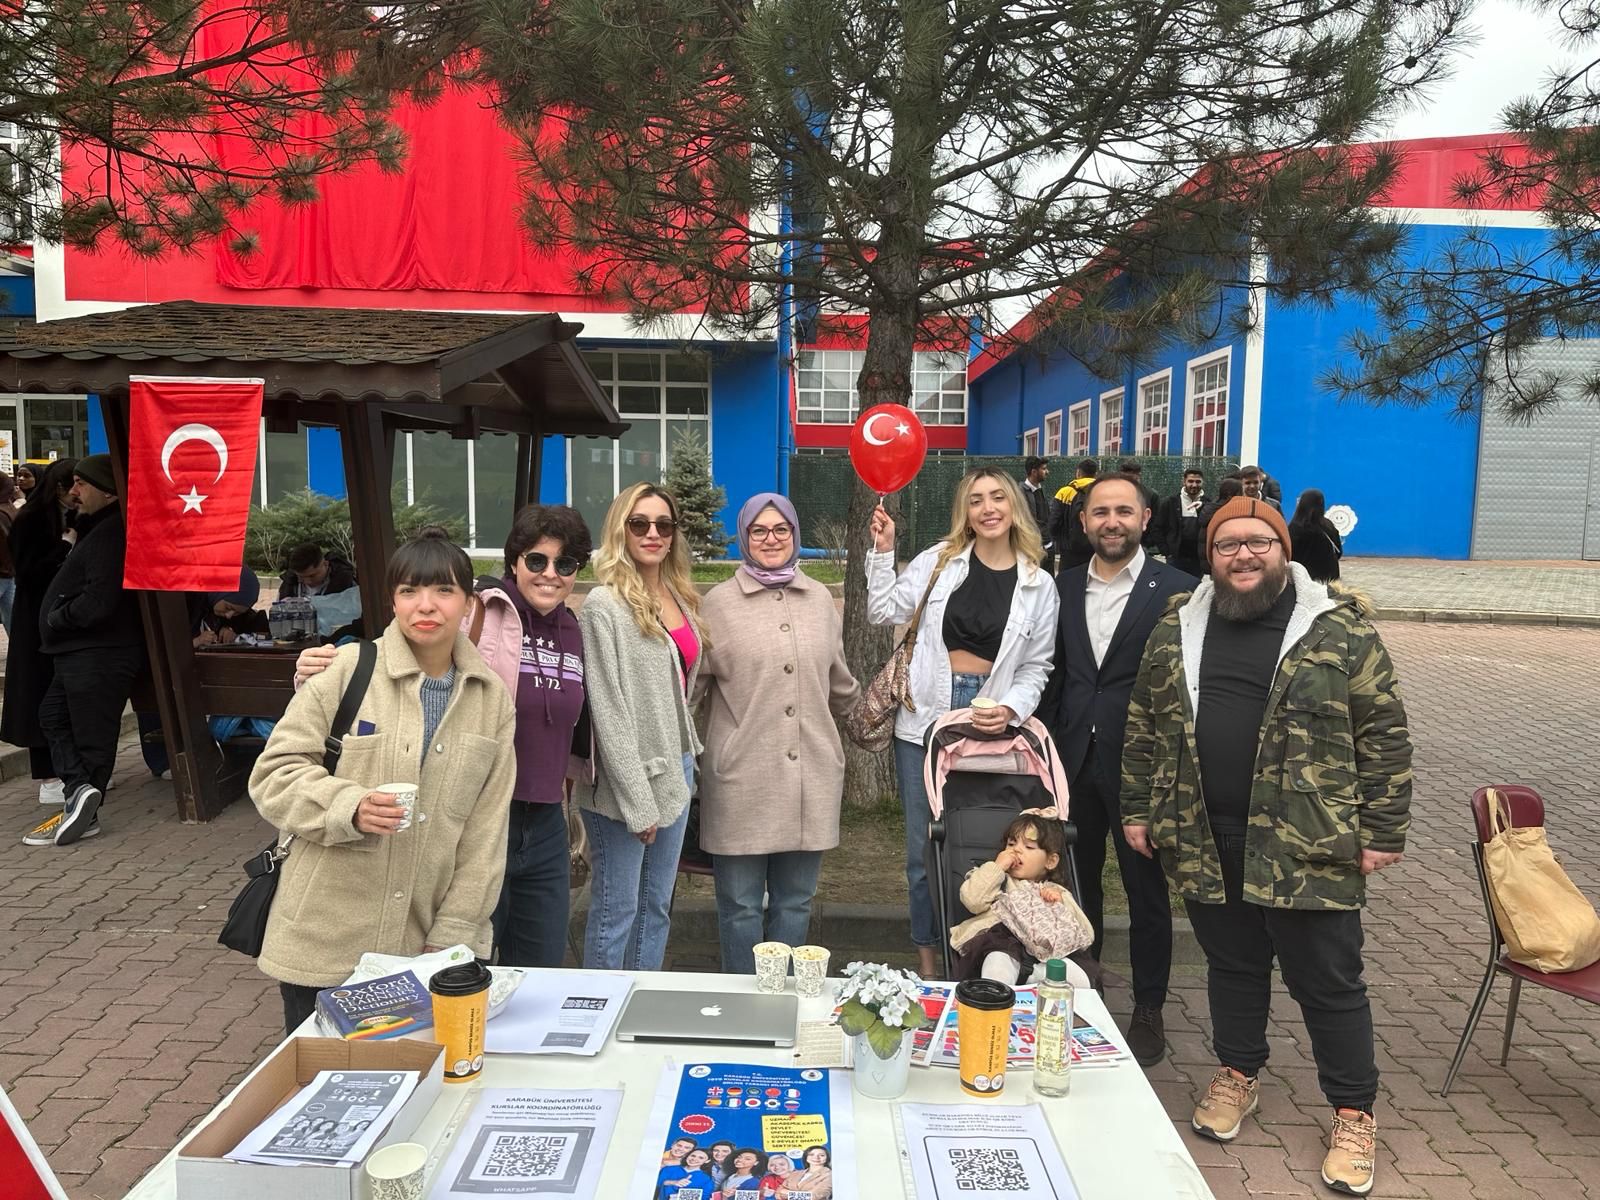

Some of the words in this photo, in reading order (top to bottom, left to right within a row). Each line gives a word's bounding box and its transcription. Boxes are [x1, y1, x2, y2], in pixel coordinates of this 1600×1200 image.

[330, 975, 411, 999] Oxford
[336, 982, 415, 1005] ADVANCED
[341, 993, 420, 1014] Dictionary
